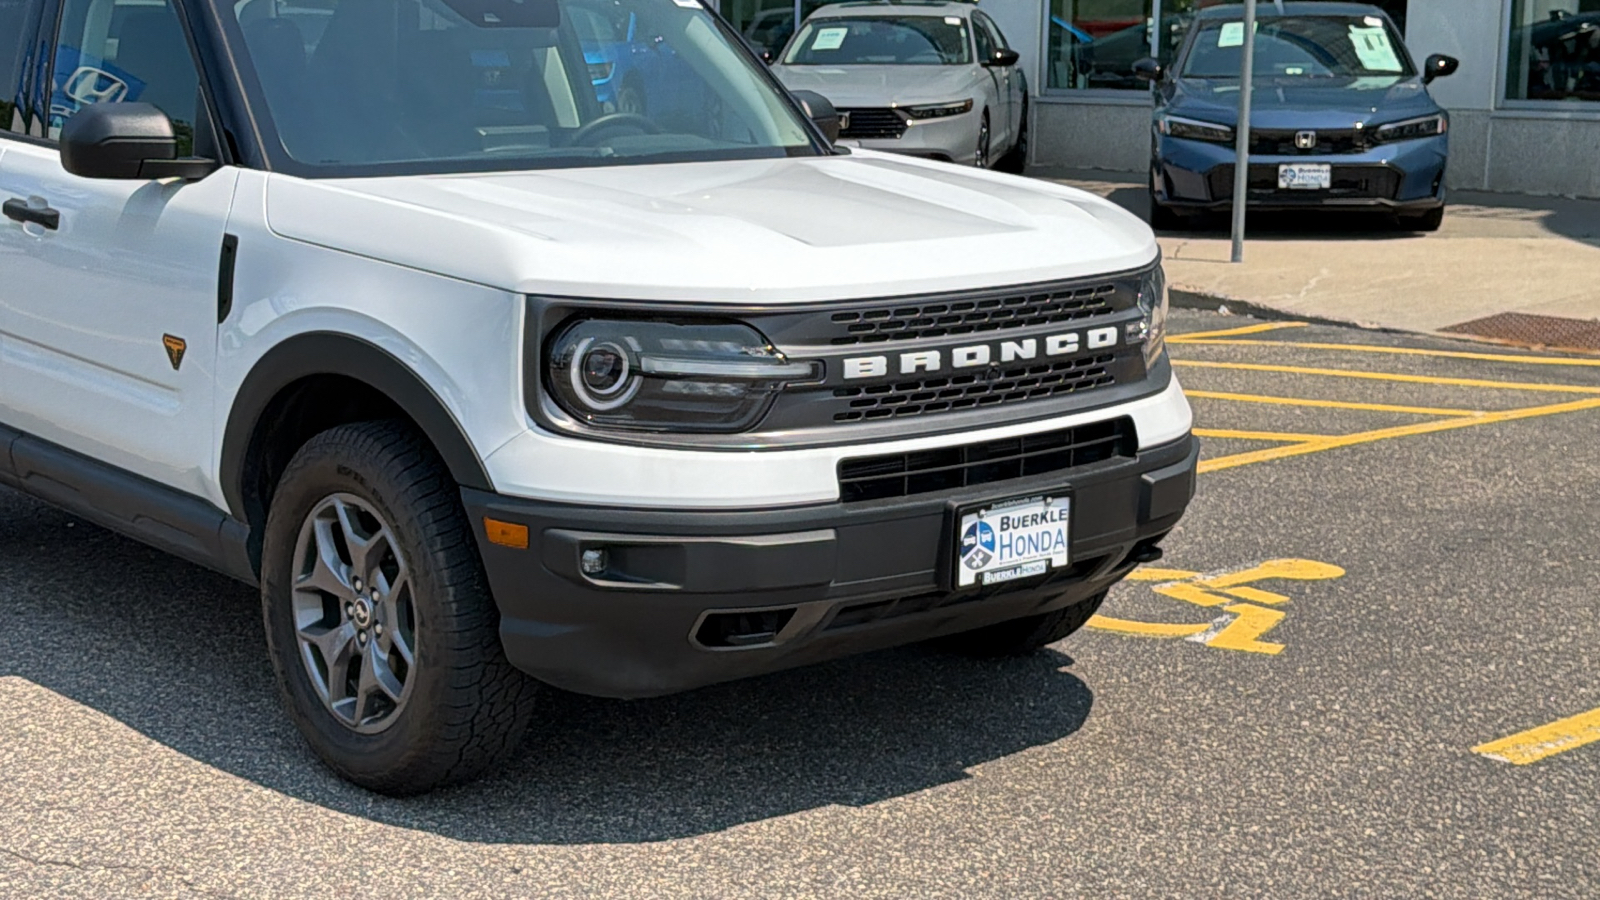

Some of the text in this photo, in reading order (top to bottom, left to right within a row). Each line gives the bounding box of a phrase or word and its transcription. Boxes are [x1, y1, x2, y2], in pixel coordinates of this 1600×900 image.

[843, 326, 1118, 380] BRONCO
[1000, 508, 1068, 532] BUERKLE
[999, 528, 1066, 560] HONDA
